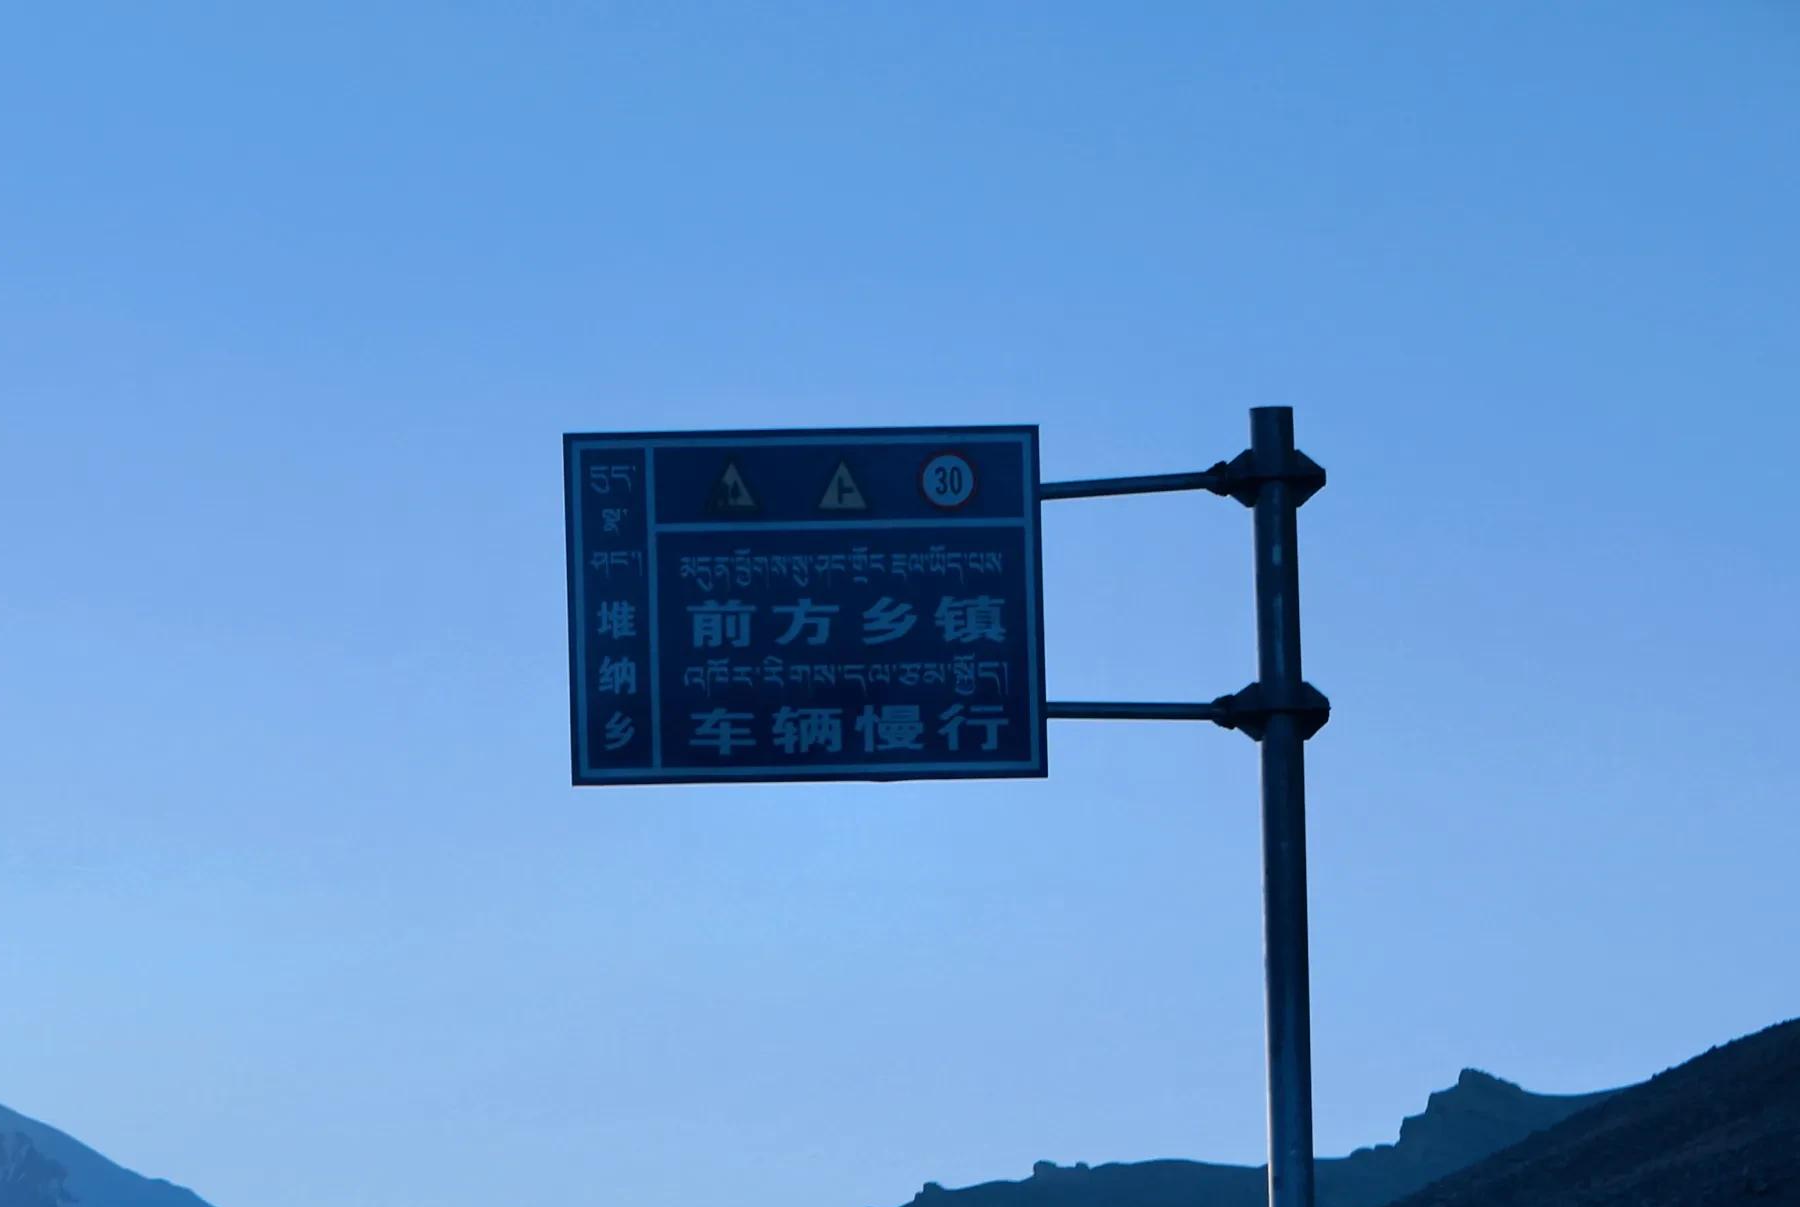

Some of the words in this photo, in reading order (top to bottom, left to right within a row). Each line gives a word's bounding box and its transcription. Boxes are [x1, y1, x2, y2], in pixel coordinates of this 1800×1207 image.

[935, 466, 962, 496] 30
[687, 597, 1006, 647] 前方乡镇
[597, 601, 637, 750] 堆纳乡
[690, 703, 1009, 755] 车辆慢行
